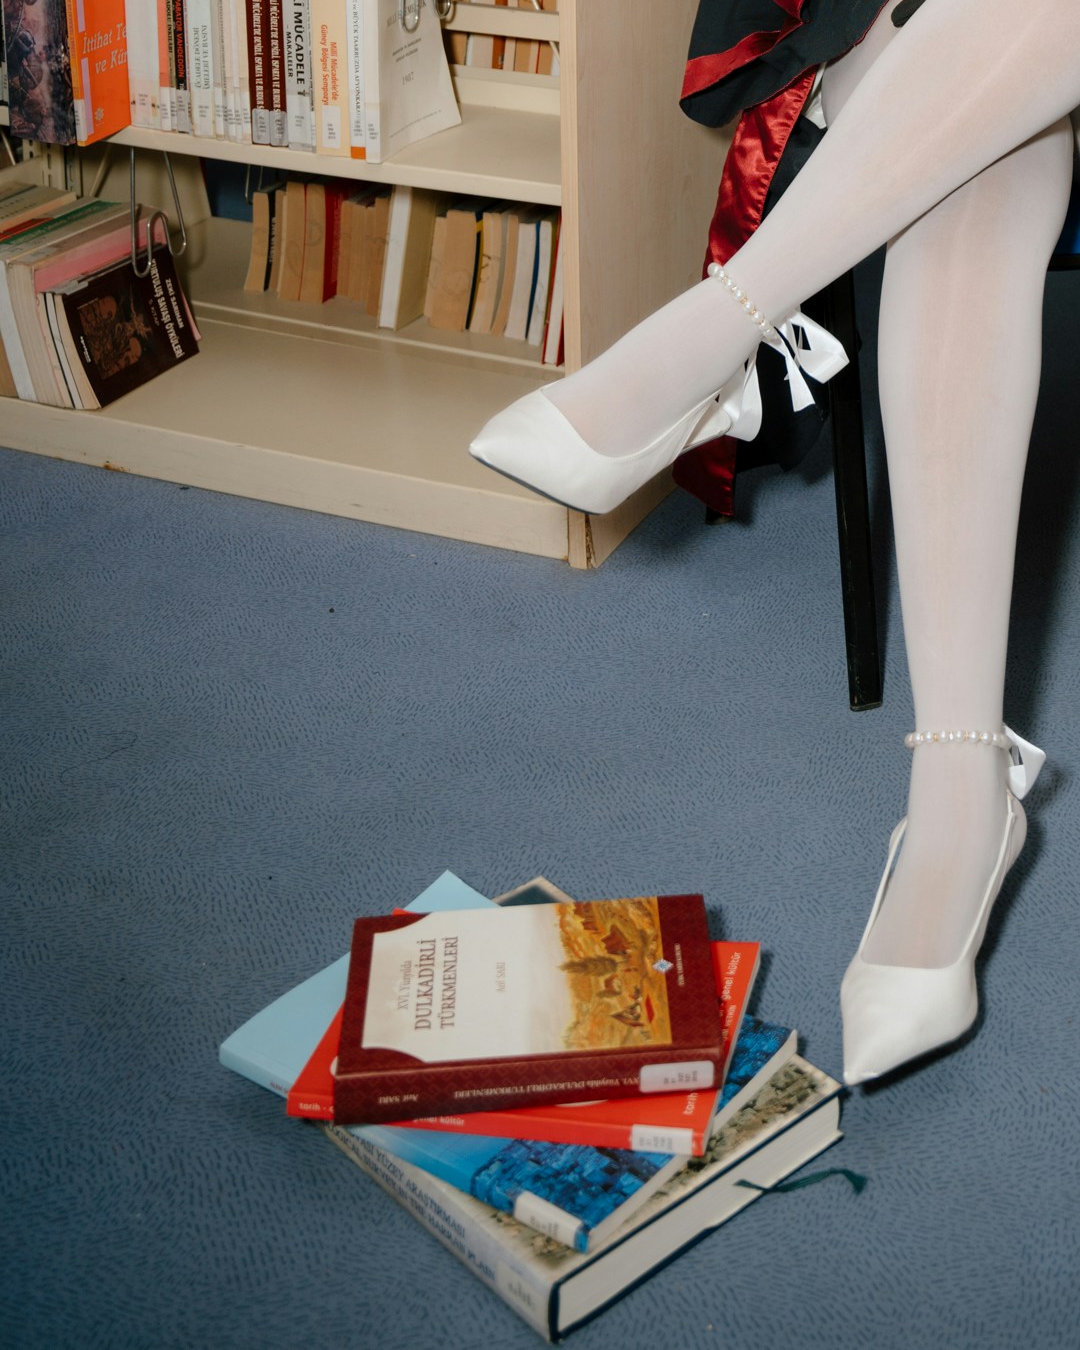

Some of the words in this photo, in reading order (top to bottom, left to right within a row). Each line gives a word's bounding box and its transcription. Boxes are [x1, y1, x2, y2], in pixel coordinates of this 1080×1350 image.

[82, 30, 113, 55] İttihat
[320, 24, 328, 47] Güney
[176, 33, 184, 77] VAHDEDDİN
[286, 31, 294, 78] MAKALELER
[320, 48, 328, 70] Bölgesi
[95, 61, 106, 75] ve
[726, 952, 742, 976] kültür
[414, 938, 437, 1031] DULKADİRLİ
[437, 936, 459, 1030] TÜRKMENLERİ
[720, 977, 734, 1001] genel
[378, 1095, 400, 1105] SARI
[400, 1093, 419, 1103] Arif
[683, 1092, 698, 1116] tarih
[298, 1102, 321, 1112] tarih
[439, 1116, 465, 1126] kültür
